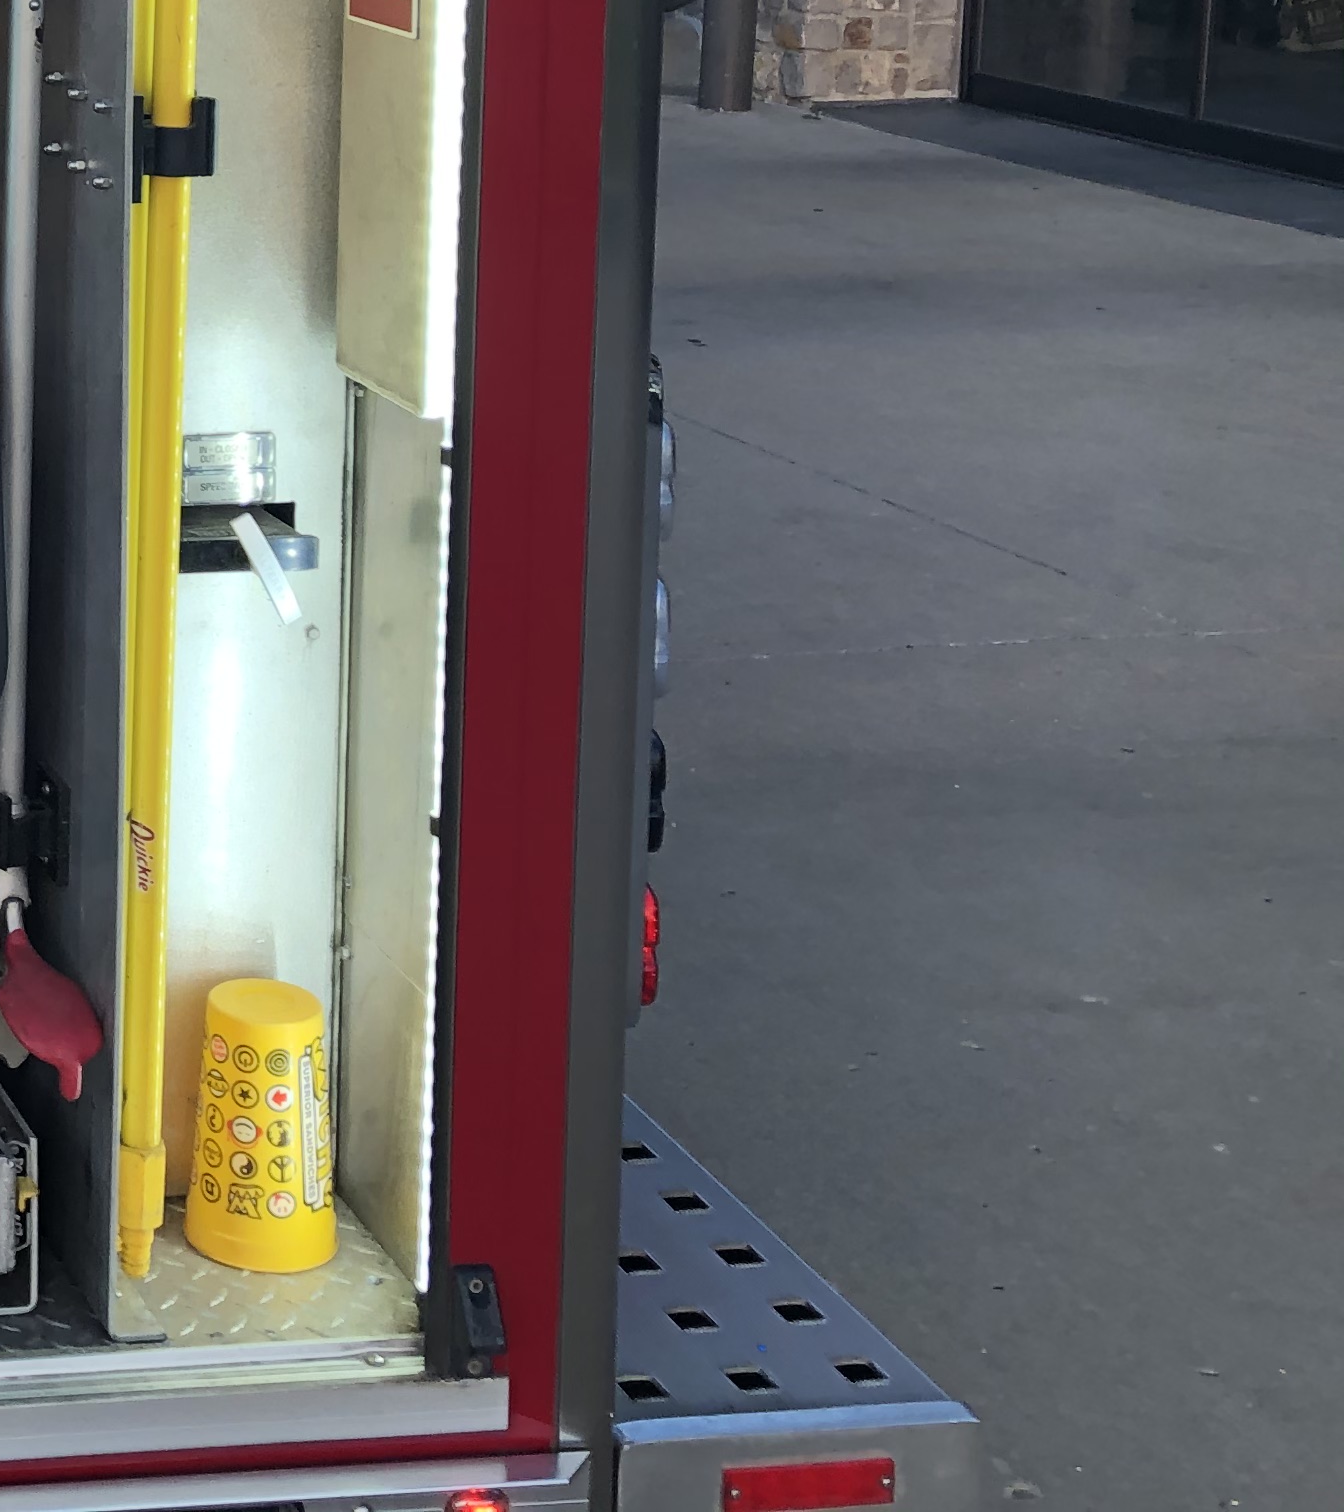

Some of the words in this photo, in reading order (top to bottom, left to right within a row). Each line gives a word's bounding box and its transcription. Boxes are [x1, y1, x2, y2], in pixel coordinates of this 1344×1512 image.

[126, 809, 155, 891] Quickie
[302, 1060, 313, 1120] SUPERIOR
[305, 1122, 318, 1199] SANDWICHES
